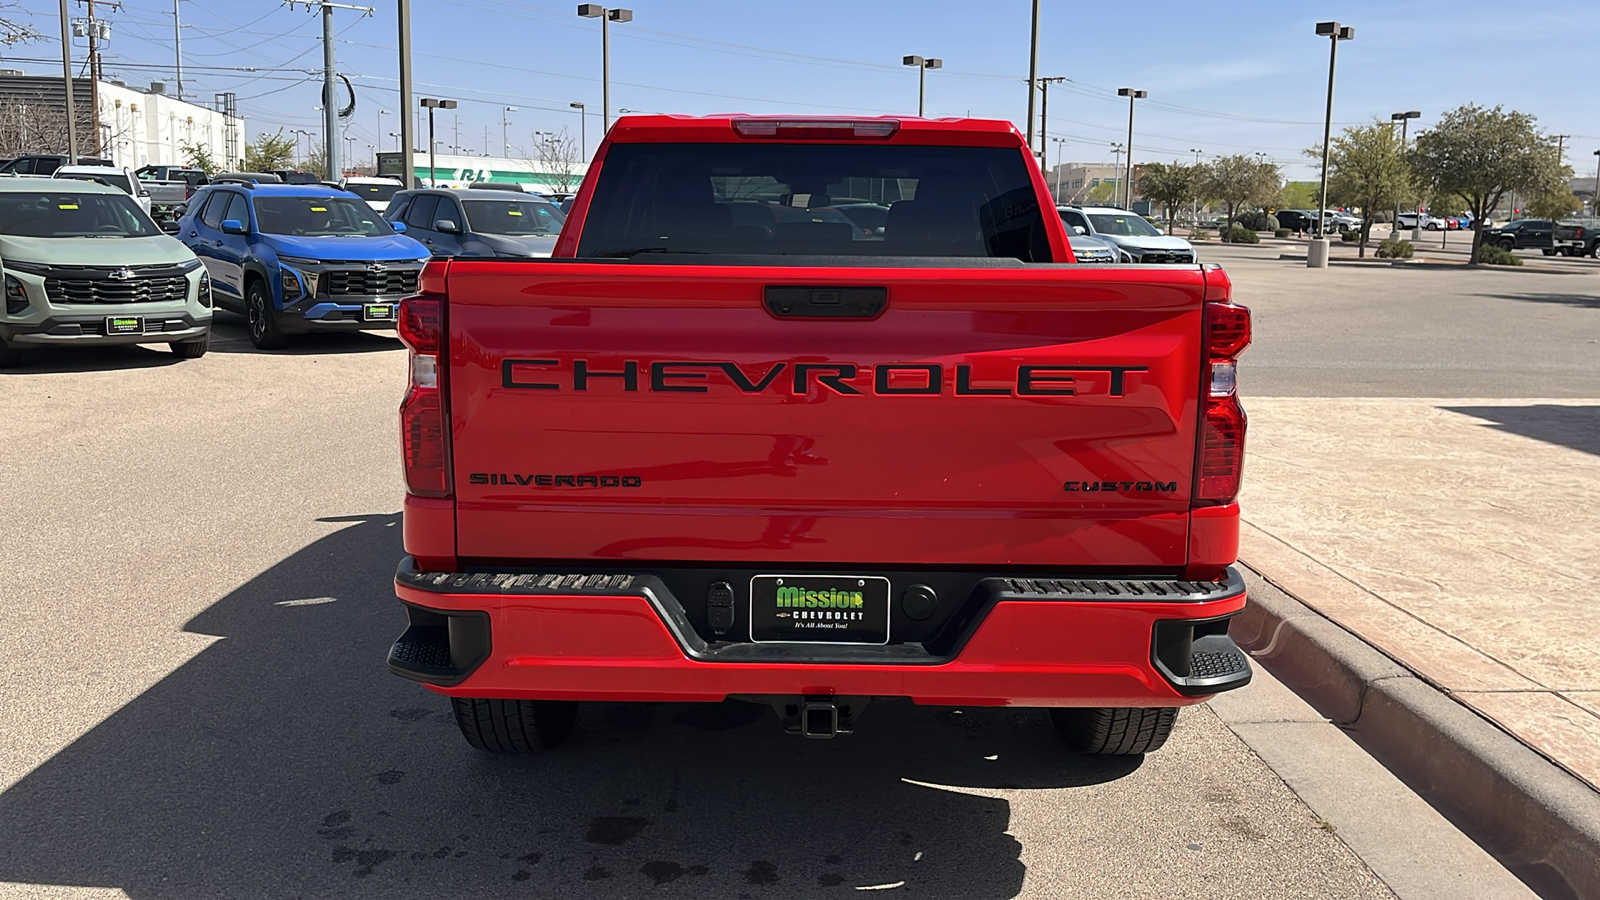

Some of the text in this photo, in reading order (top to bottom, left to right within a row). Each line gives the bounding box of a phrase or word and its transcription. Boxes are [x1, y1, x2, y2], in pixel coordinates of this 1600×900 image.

[502, 359, 1148, 398] CHEVROLET
[469, 473, 642, 488] SILVERADO
[1063, 481, 1178, 492] CUSTOM
[776, 586, 864, 609] Mission
[792, 611, 864, 620] CHEVROLET
